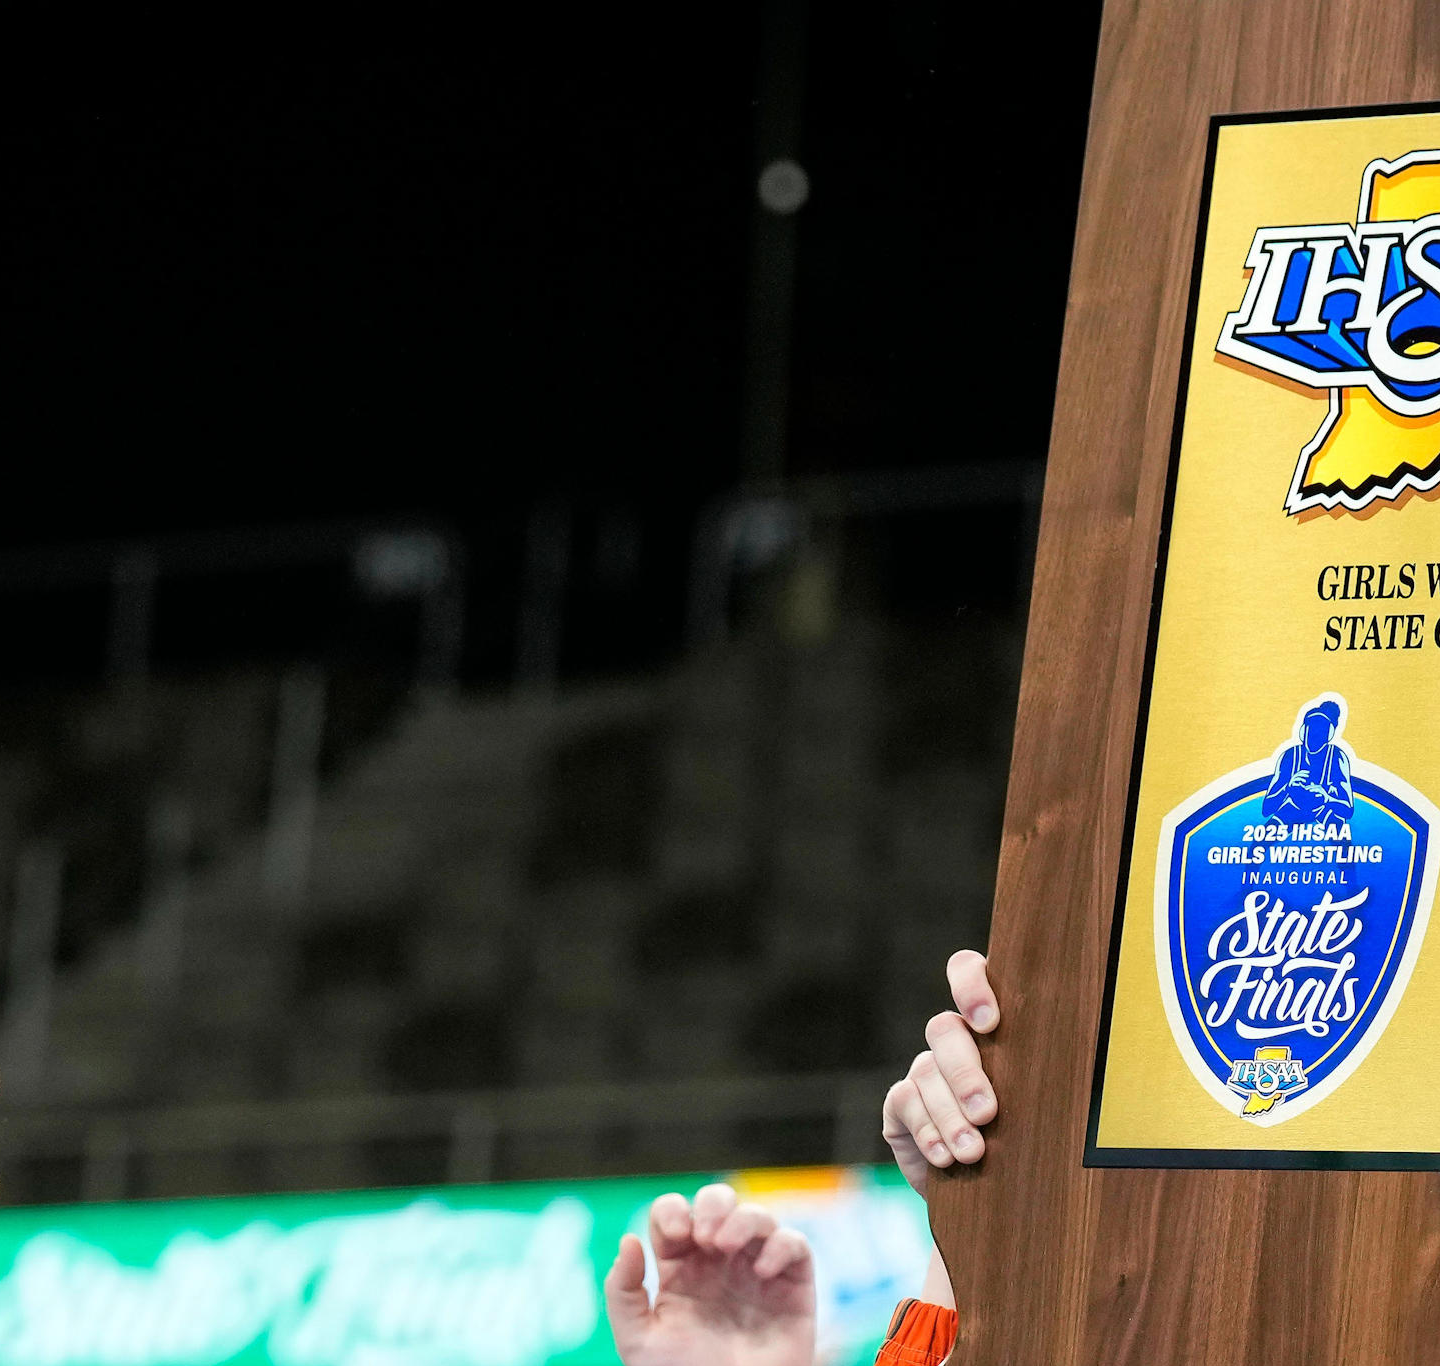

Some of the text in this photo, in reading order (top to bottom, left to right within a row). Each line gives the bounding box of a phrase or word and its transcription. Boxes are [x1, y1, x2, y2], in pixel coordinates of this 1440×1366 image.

[1316, 563, 1417, 601] GIRLS
[1323, 613, 1424, 652] STATE
[1243, 823, 1351, 842] 2025 IHSAA
[1207, 844, 1383, 865] GIRLS WRESTLING
[1241, 870, 1348, 885] INAUGURAL
[1208, 887, 1369, 963] State
[1199, 952, 1360, 1040] Finals
[1231, 1062, 1305, 1094] IHSAA
